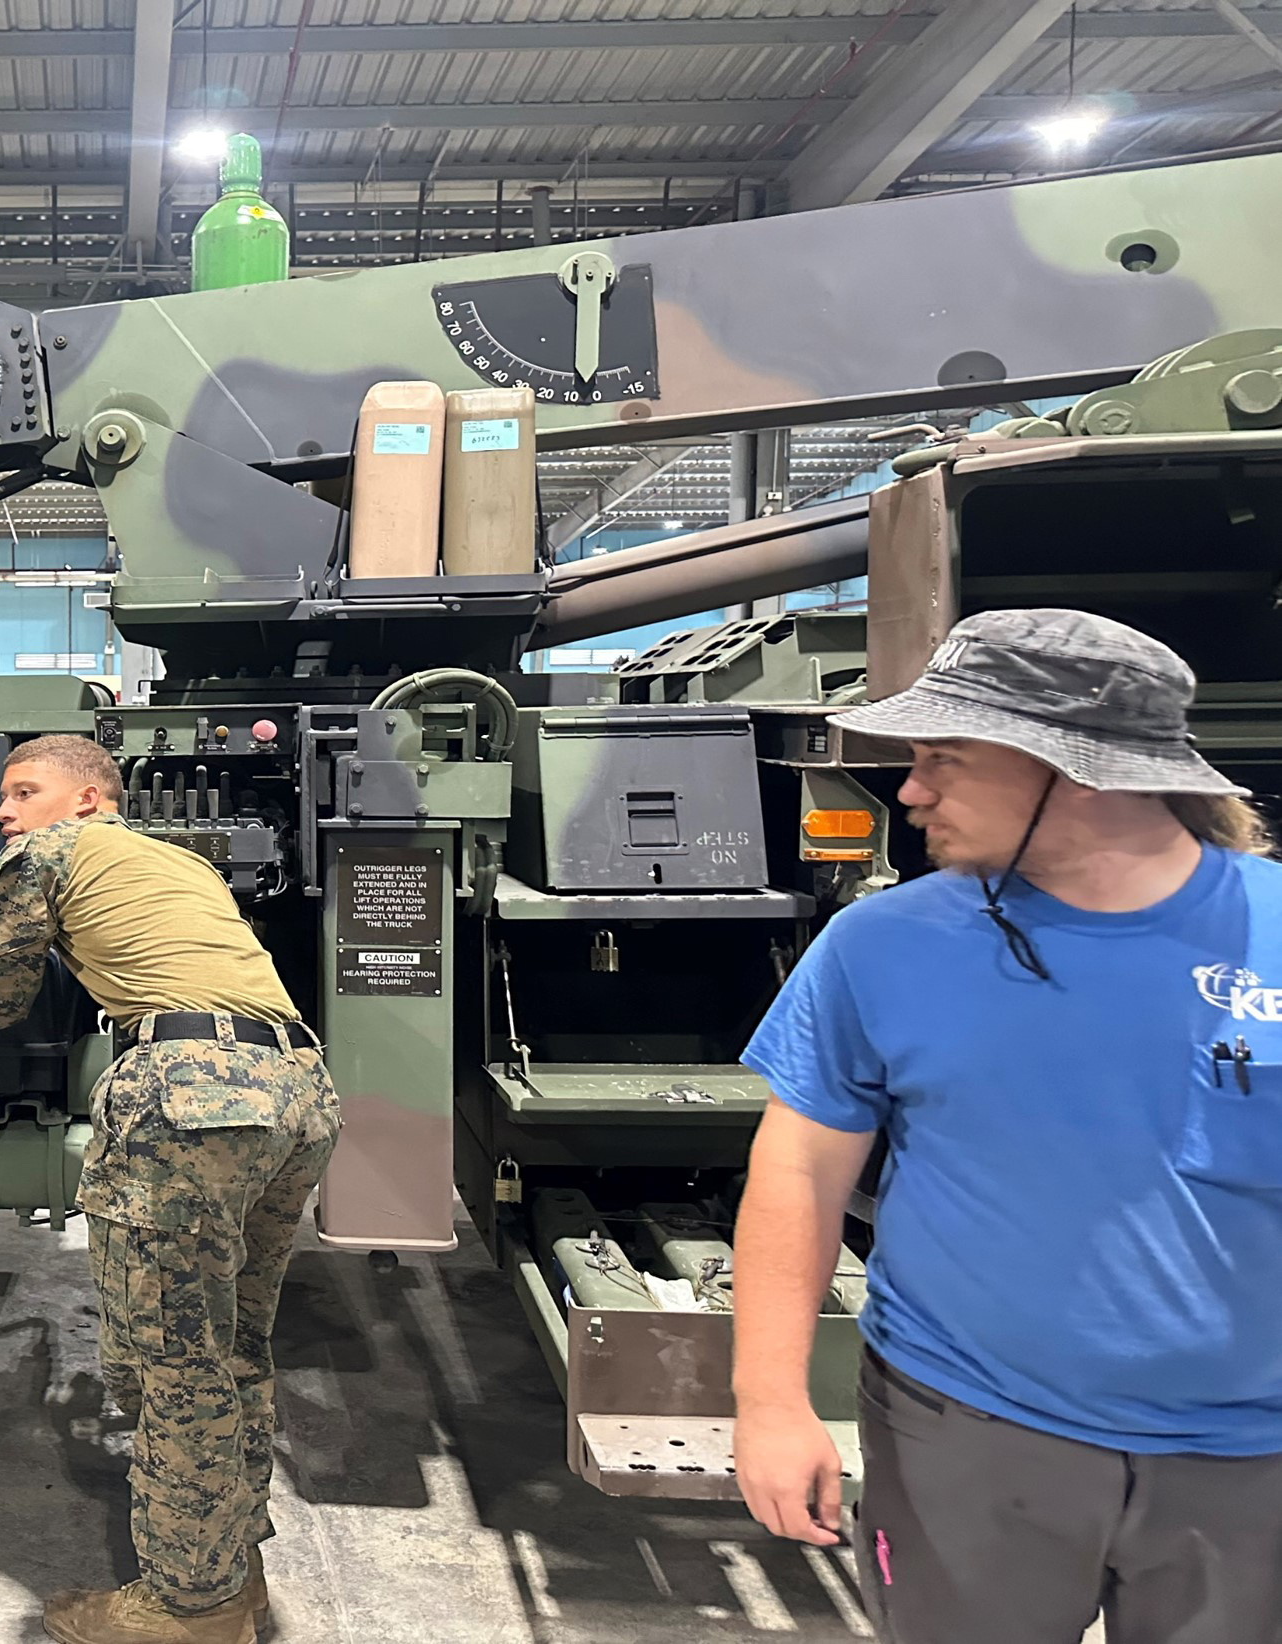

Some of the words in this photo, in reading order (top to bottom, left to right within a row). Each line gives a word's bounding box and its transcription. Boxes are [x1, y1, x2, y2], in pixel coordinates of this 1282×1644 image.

[439, 301, 454, 317] 80
[446, 320, 462, 336] 70
[458, 339, 475, 355] 60
[473, 355, 490, 371] 50
[491, 369, 509, 384] 40
[536, 387, 555, 400] 20
[592, 390, 602, 402] 0
[622, 381, 645, 396] -15
[563, 391, 579, 402] 10
[404, 865, 427, 873] LEGS
[364, 954, 414, 962] CAUTION
